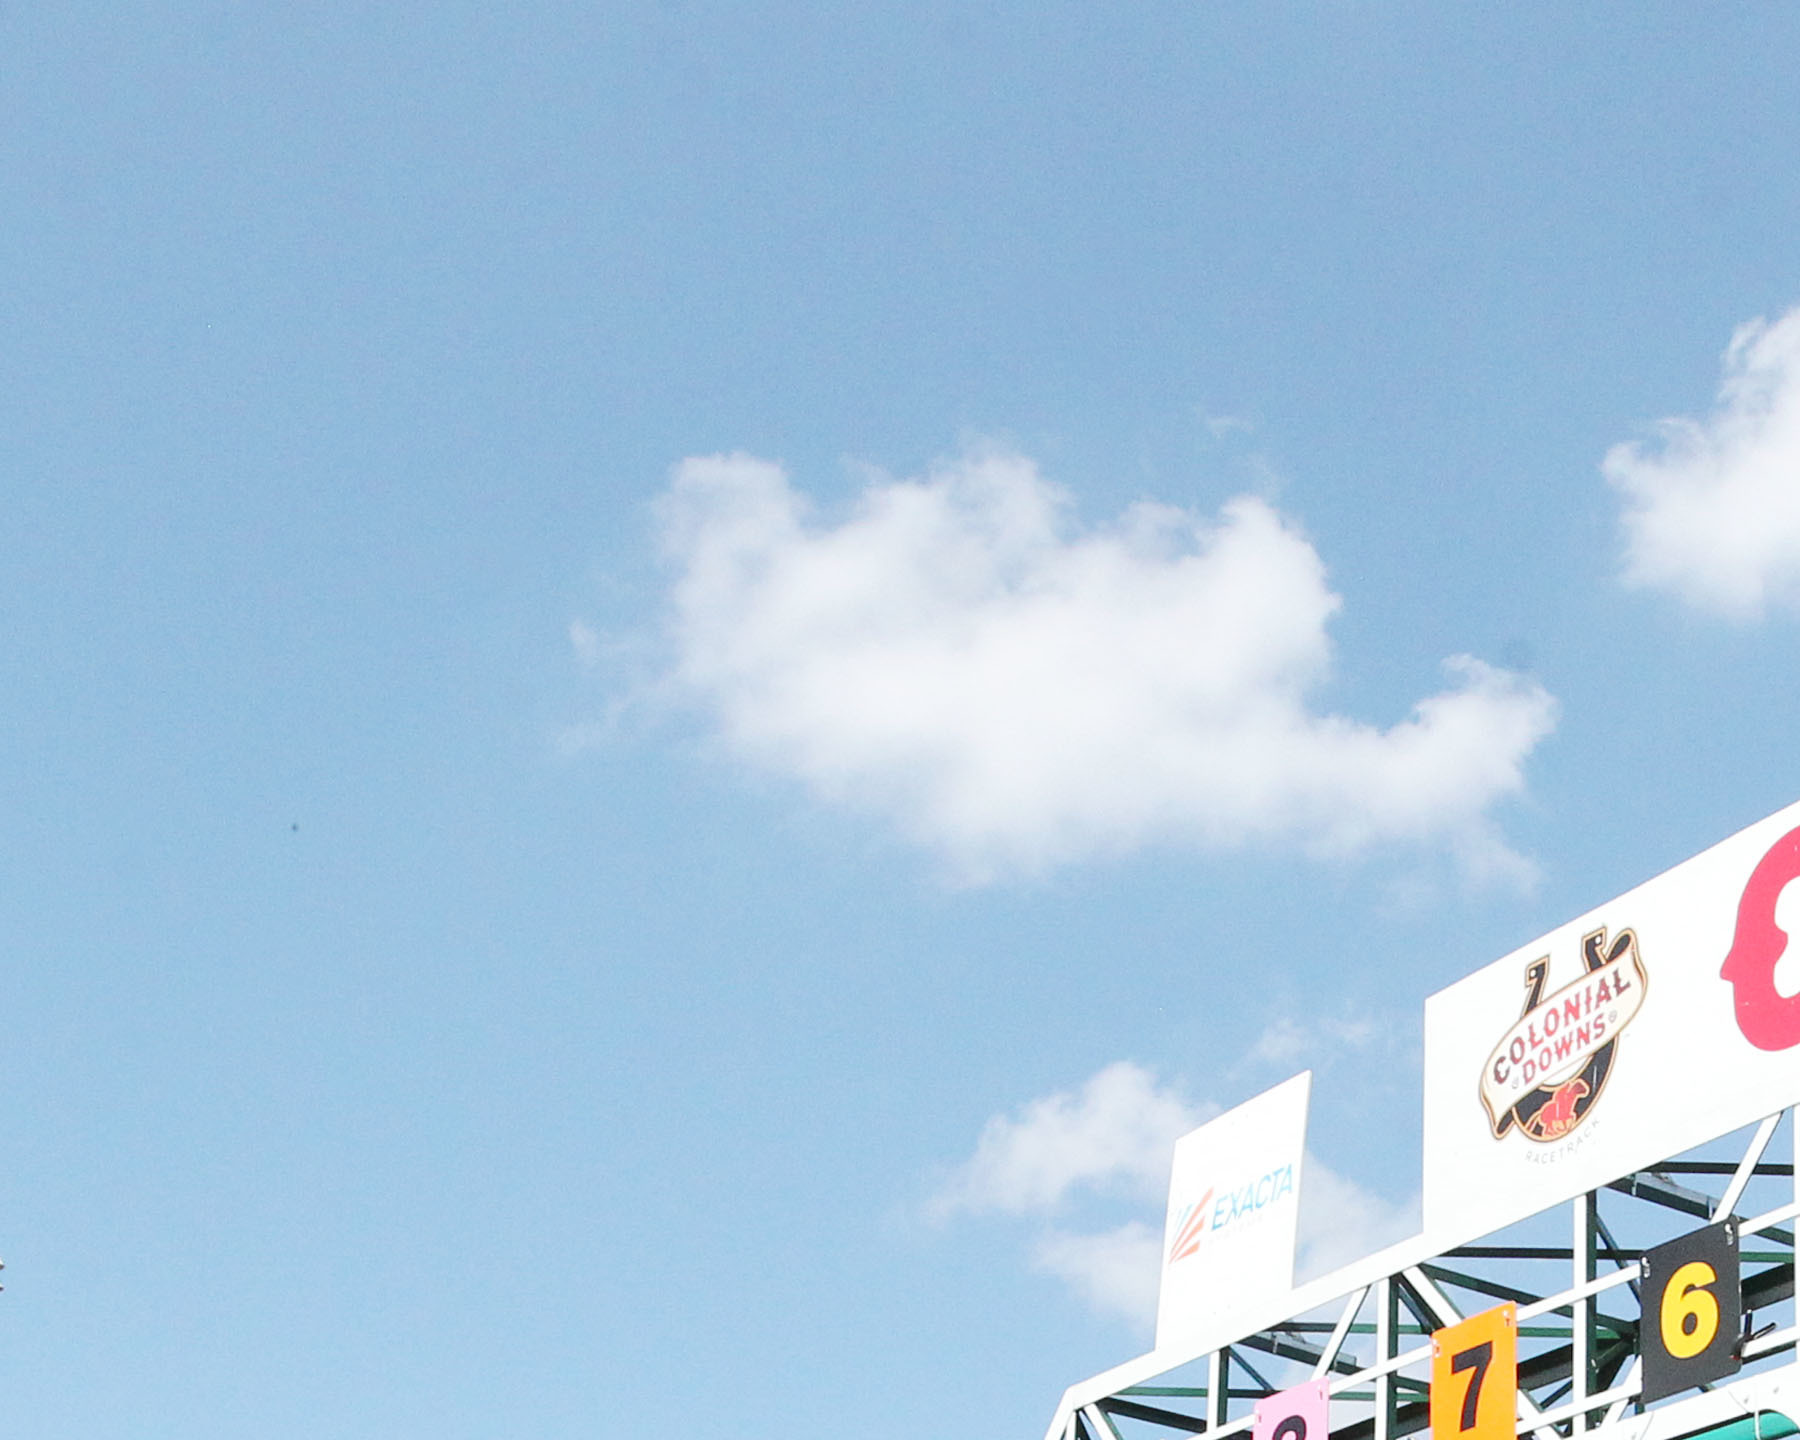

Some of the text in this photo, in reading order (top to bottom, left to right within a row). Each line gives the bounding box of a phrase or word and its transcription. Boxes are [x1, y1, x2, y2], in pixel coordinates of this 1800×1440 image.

[1493, 968, 1632, 1085] COLONIAL
[1522, 1013, 1606, 1086] DOWNS
[1524, 1119, 1601, 1166] RACETRACK
[1210, 1162, 1294, 1231] EXACTA
[1660, 1261, 1720, 1359] 6
[1451, 1340, 1494, 1433] 7
